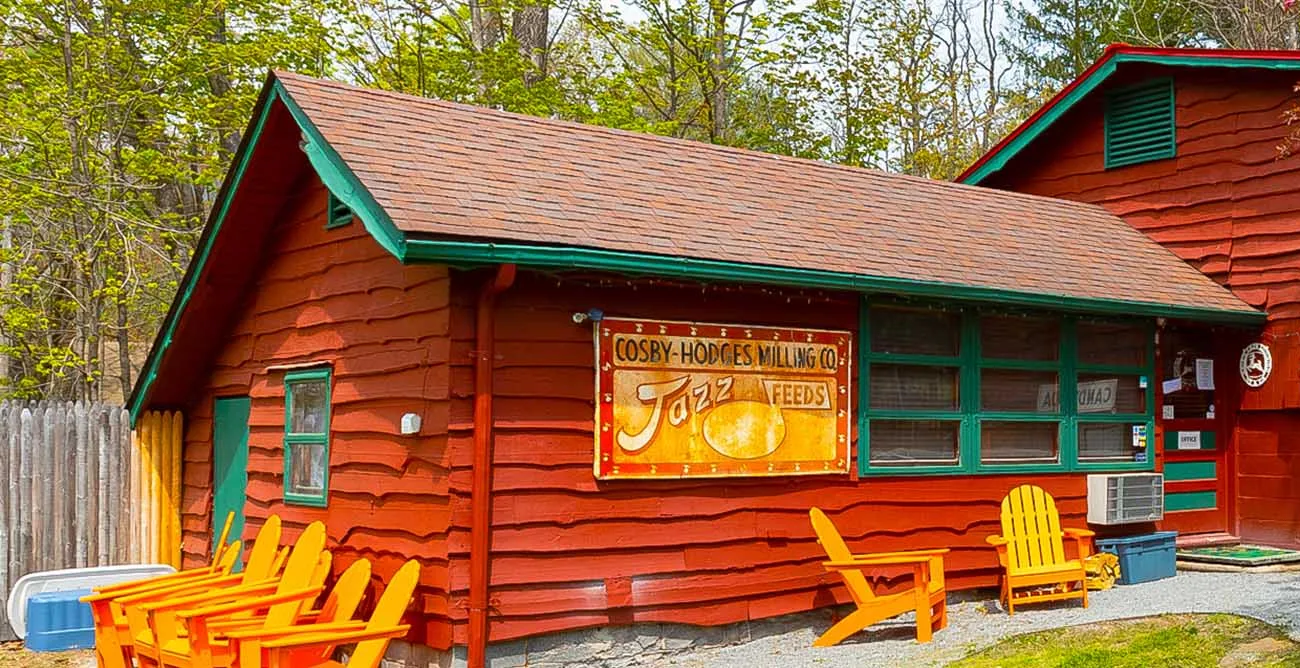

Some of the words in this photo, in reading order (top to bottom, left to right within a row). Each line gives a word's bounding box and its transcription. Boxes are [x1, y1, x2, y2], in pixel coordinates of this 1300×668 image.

[614, 337, 753, 367] COSBY-HODGES
[758, 343, 816, 370] MILLING
[772, 381, 826, 407] FEEDS
[615, 374, 735, 456] Jazz
